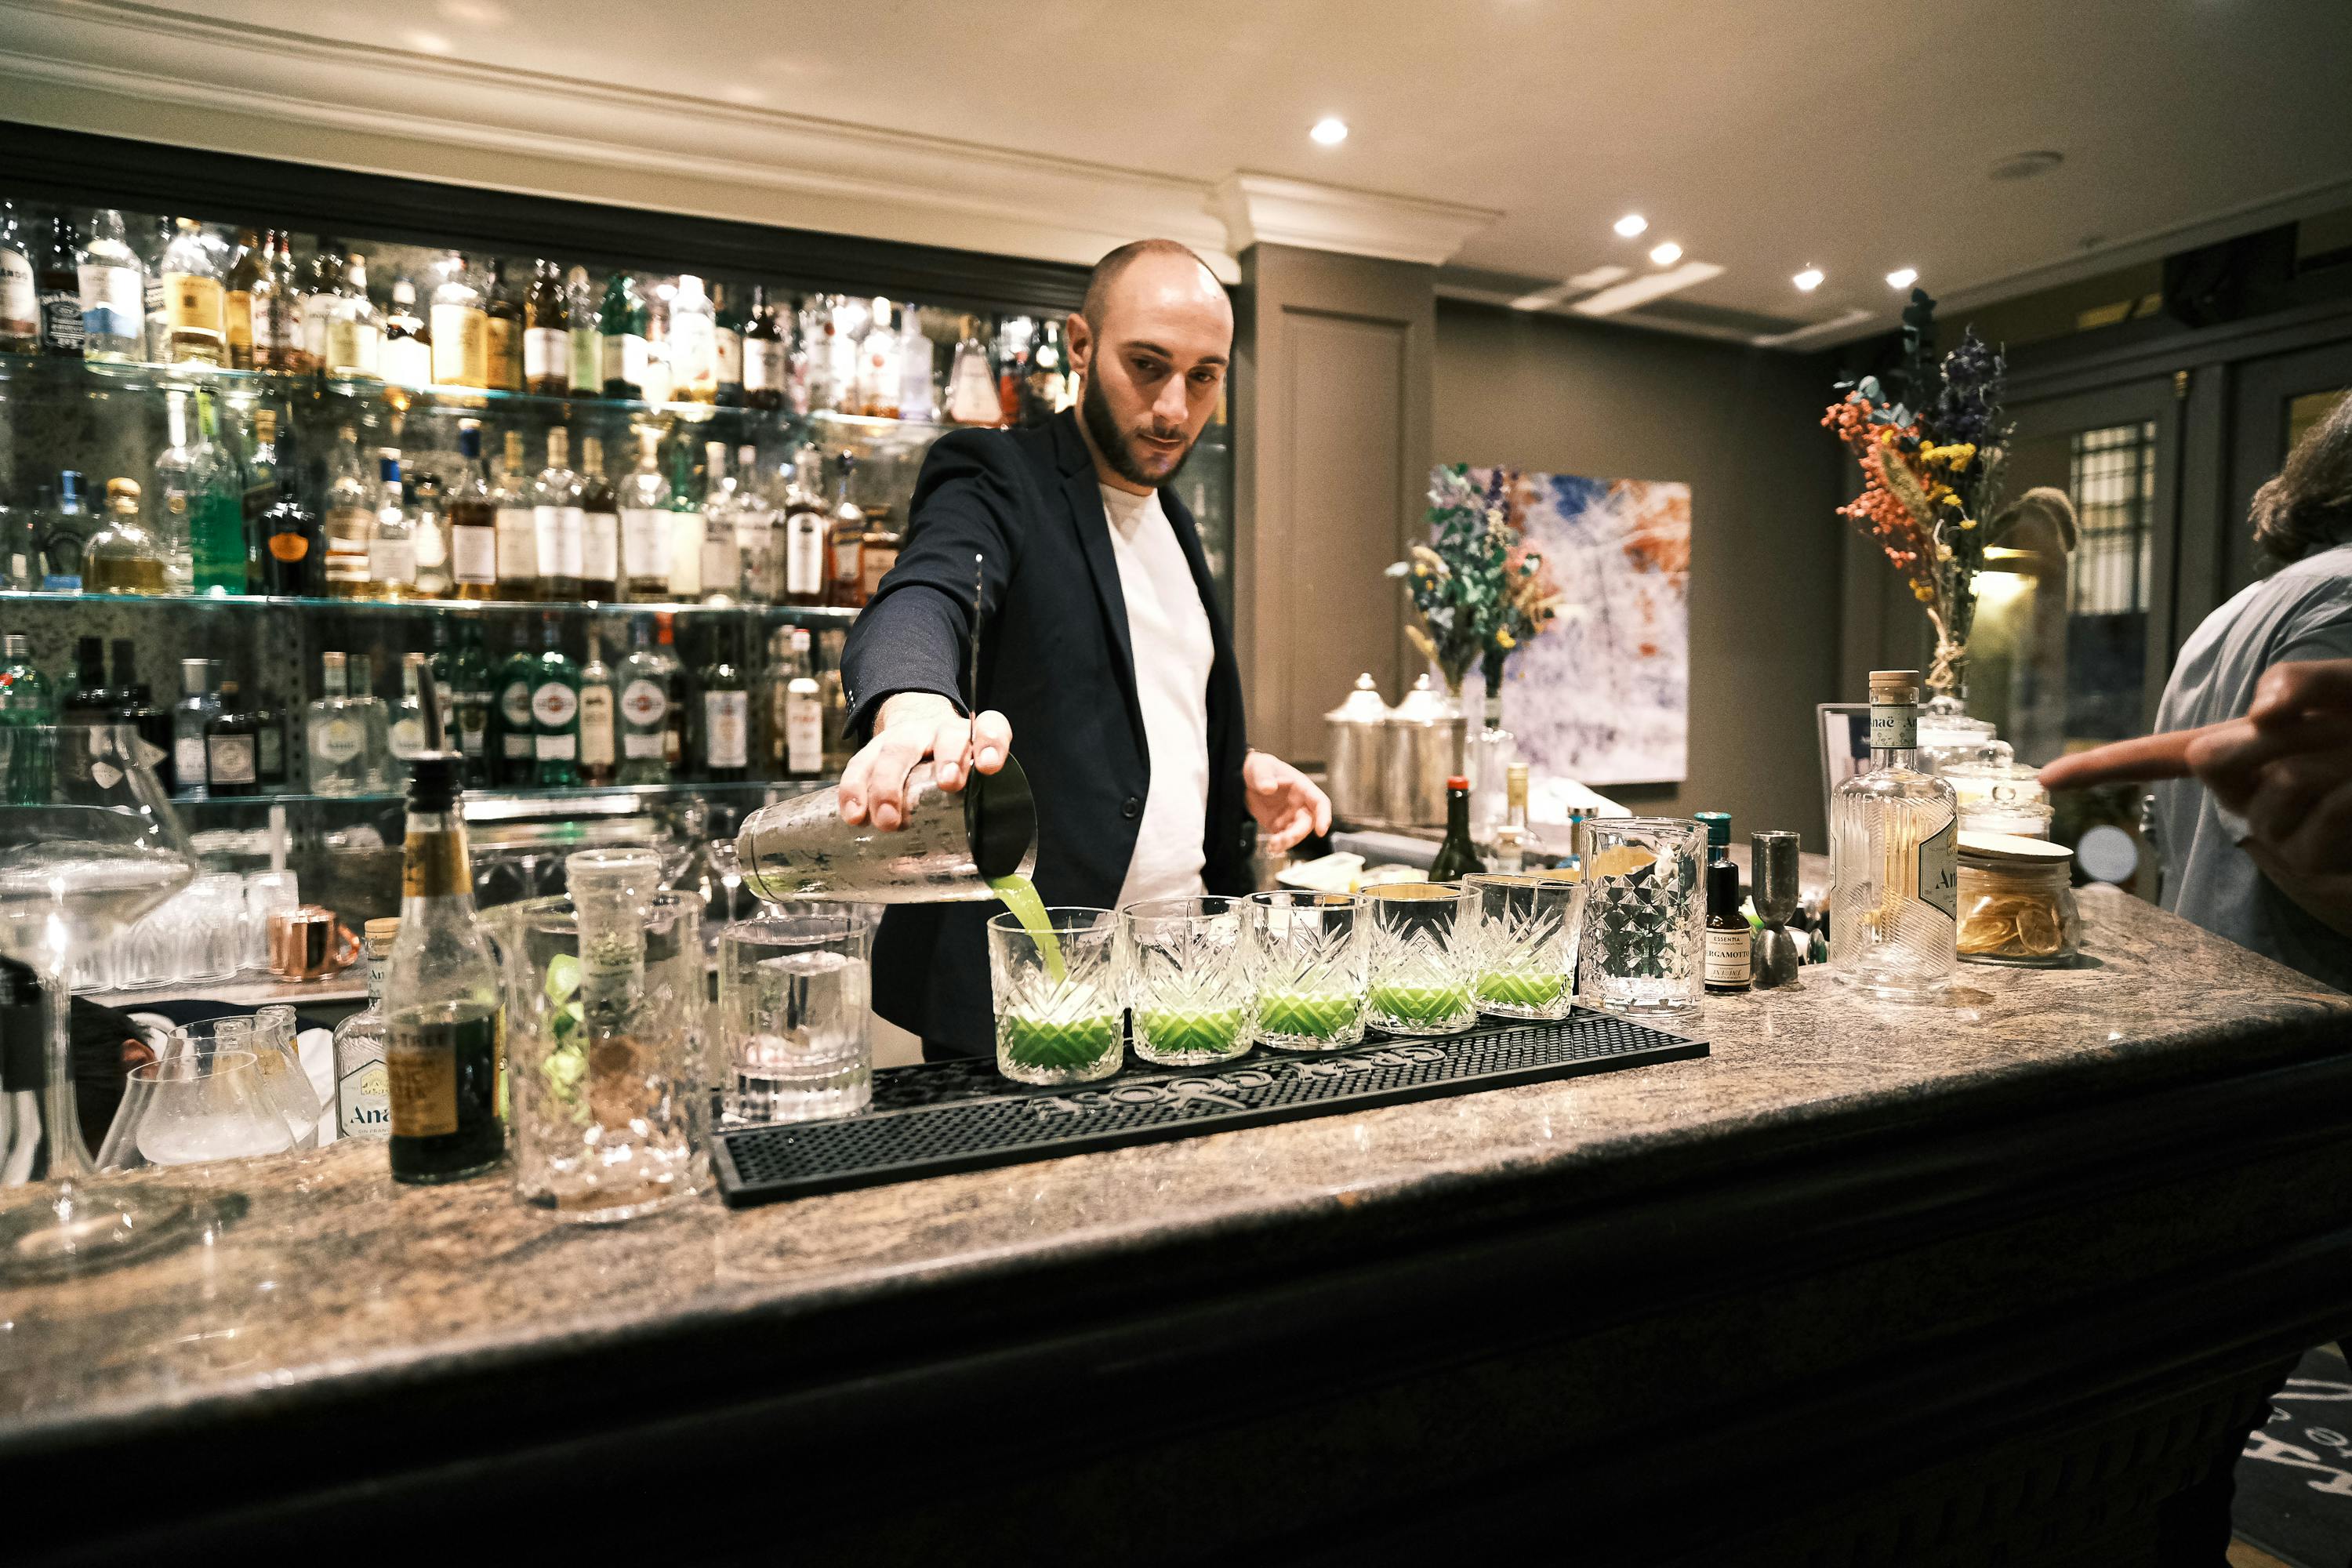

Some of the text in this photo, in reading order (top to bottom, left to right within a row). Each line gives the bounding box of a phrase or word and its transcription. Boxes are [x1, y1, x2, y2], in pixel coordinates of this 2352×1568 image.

[1871, 717, 1894, 728] naë
[1935, 869, 1957, 890] An
[1706, 949, 1750, 958] ERGAMOTTO
